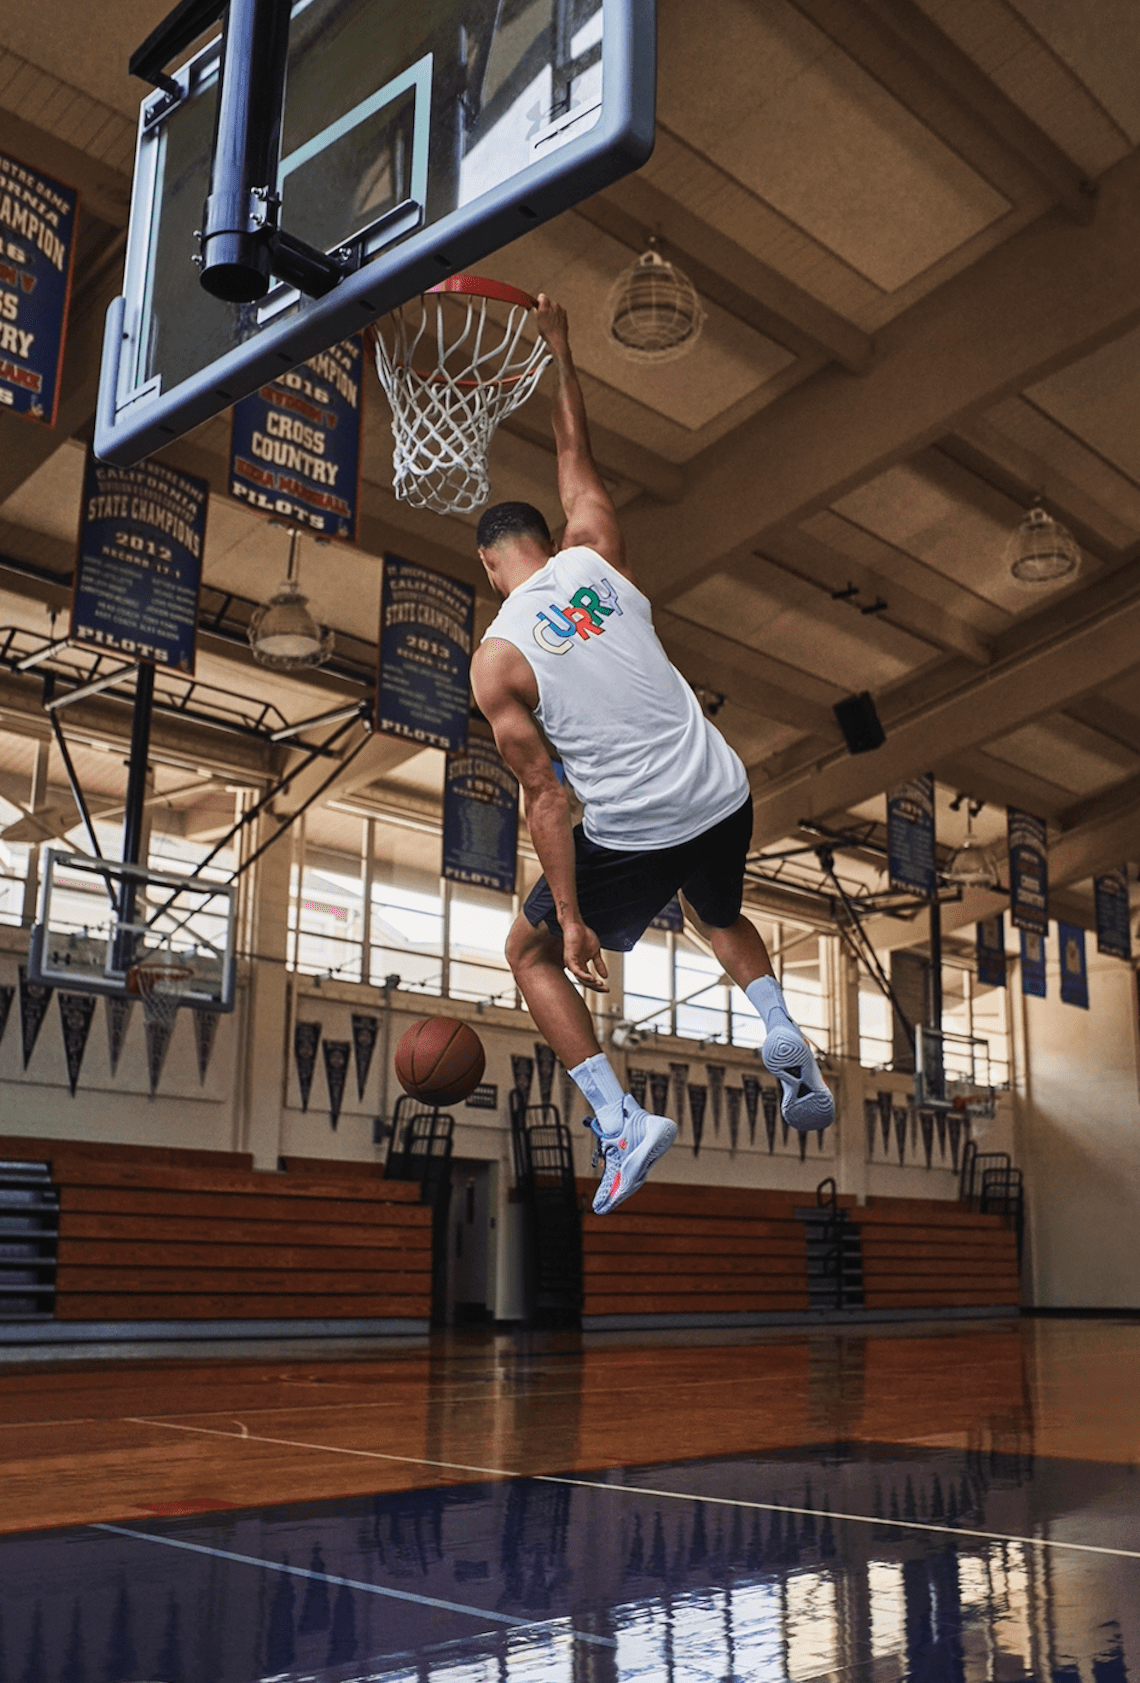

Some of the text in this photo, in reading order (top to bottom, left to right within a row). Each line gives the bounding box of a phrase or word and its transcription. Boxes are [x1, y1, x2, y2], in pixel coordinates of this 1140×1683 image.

[0, 156, 70, 216] OTRE DAME
[0, 288, 19, 321] S
[0, 320, 35, 360] RY
[266, 410, 325, 455] CROSS
[251, 431, 339, 487] COUNTRY
[95, 467, 198, 517] CALIFORNIA
[231, 480, 325, 530] PILOTS
[88, 493, 129, 521] STATE
[131, 496, 200, 559] CHAMPIONS
[115, 532, 172, 562] 2012
[533, 578, 623, 656] CURRY
[77, 624, 169, 663] PILOTS
[405, 634, 450, 659] 2013
[381, 718, 450, 749] PILOTS
[445, 865, 501, 888] PILOTS
